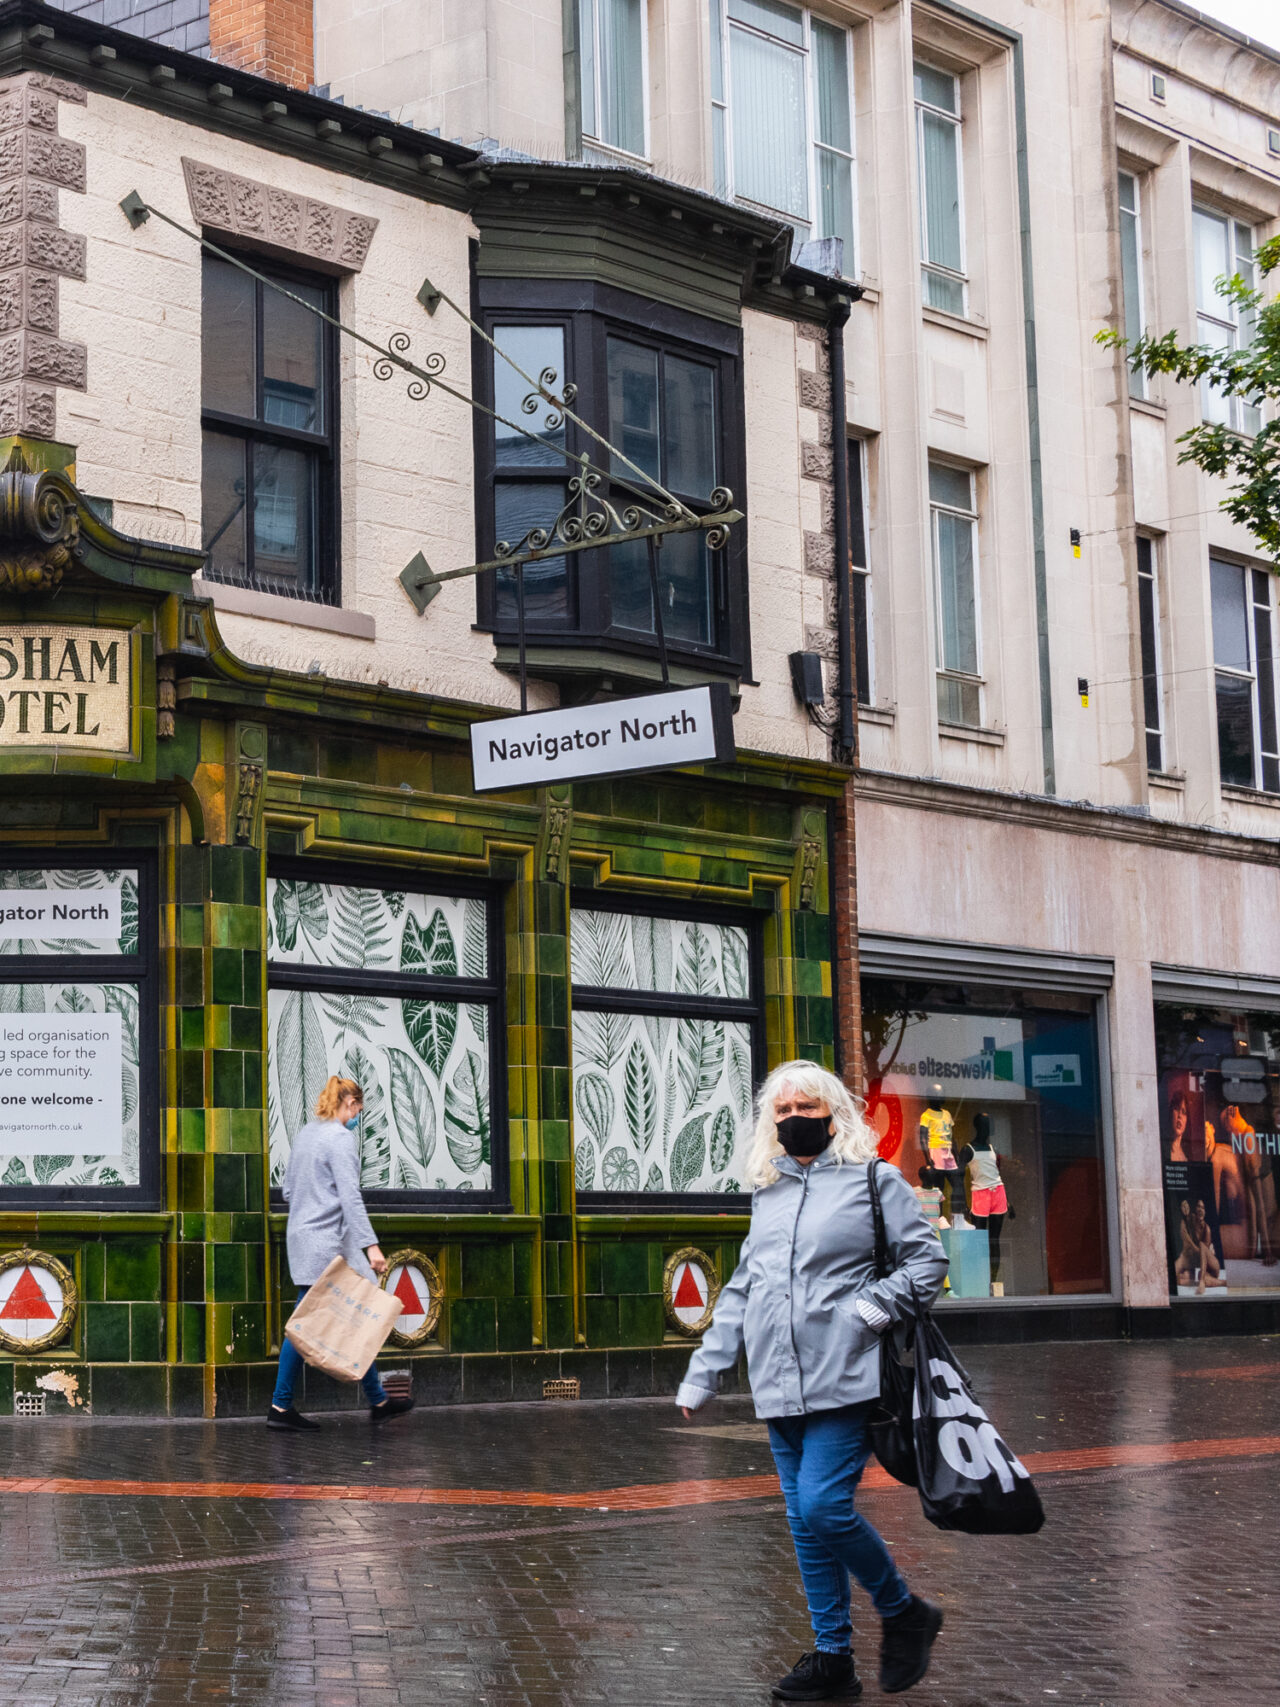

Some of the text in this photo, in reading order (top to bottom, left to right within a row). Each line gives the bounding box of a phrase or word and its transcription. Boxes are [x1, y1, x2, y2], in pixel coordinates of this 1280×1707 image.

[489, 709, 697, 763] Navigator North
[52, 903, 109, 920] North
[3, 1028, 24, 1041] led
[28, 1029, 109, 1044] organisation
[10, 1050, 48, 1062] space
[53, 1046, 71, 1059] for
[75, 1047, 96, 1059] the
[17, 1065, 93, 1079] community.
[31, 1093, 94, 1105] welcome
